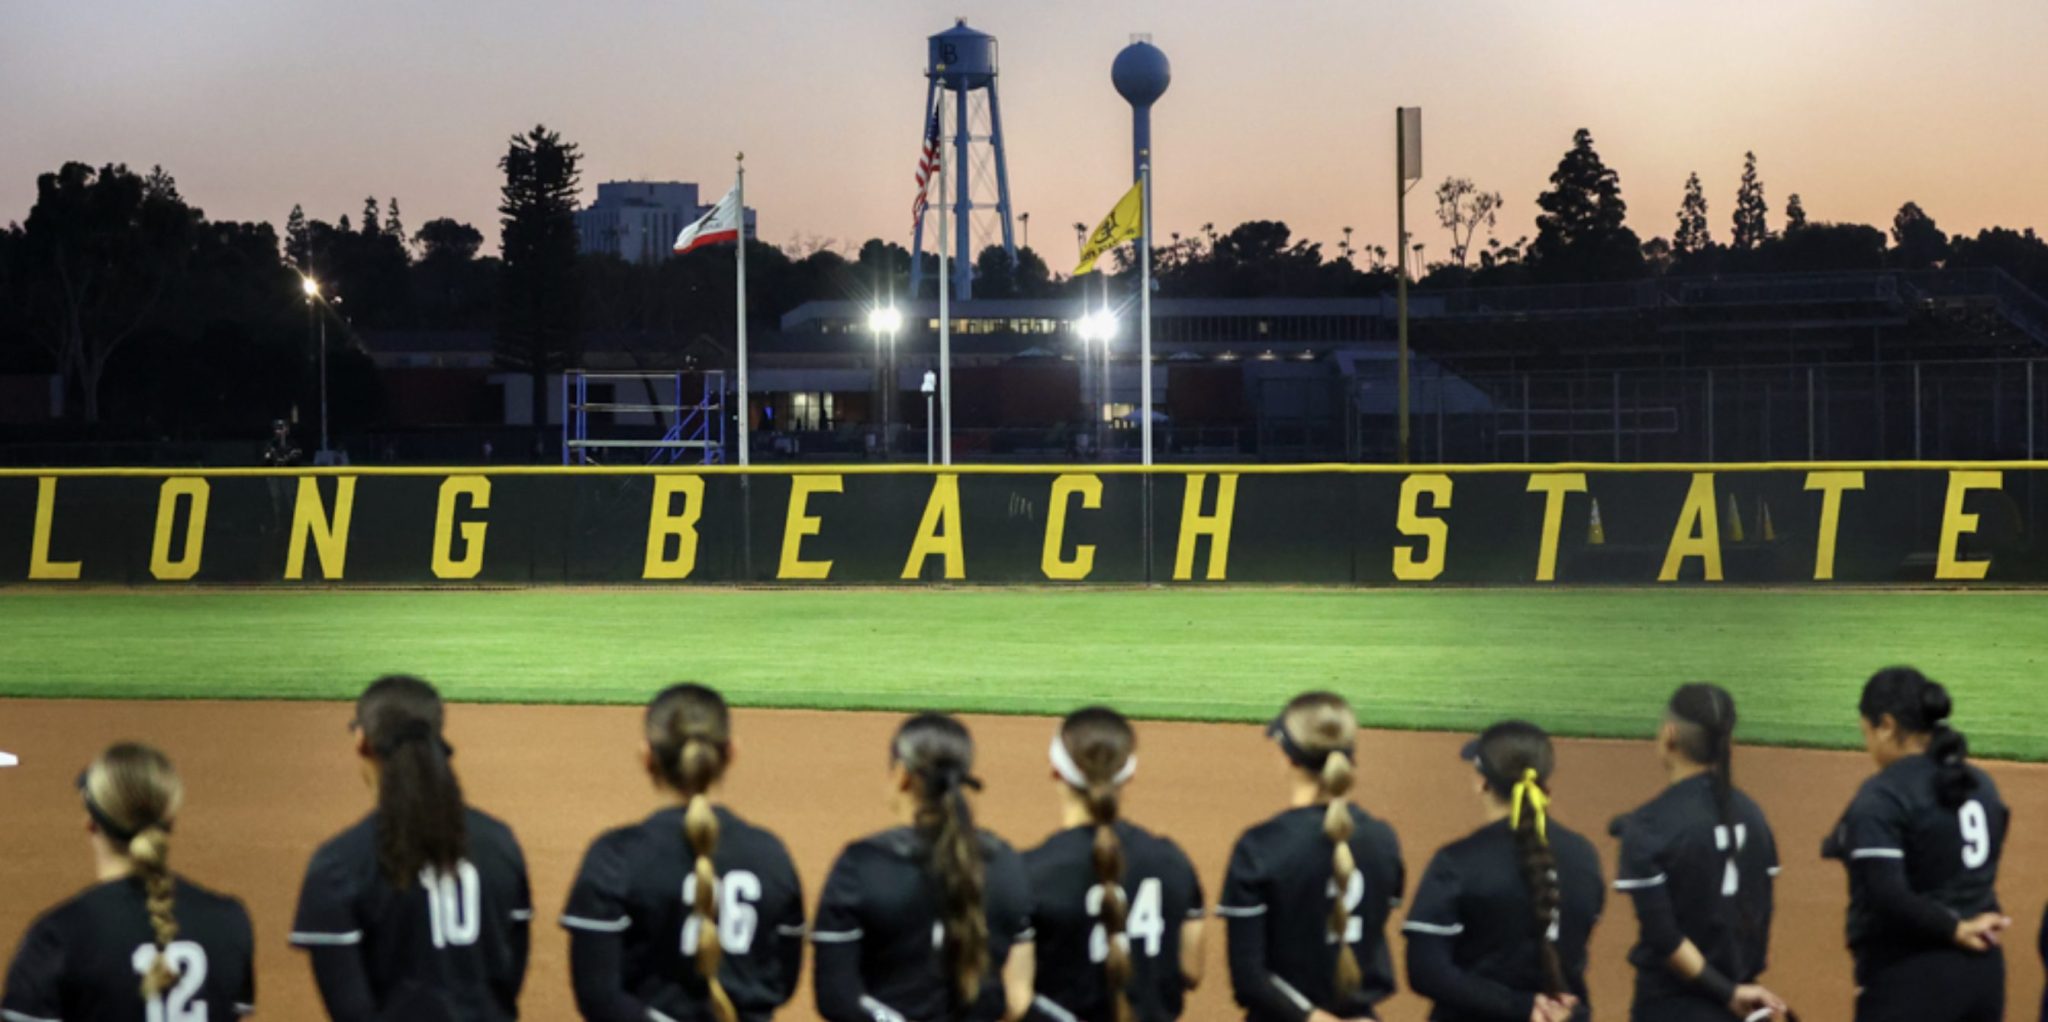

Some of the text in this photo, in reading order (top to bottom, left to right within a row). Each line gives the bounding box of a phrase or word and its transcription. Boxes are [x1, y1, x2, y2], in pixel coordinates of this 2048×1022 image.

[29, 471, 2002, 580] LONG BEACH STATE
[1958, 799, 1989, 868] 9
[418, 858, 479, 948] 10
